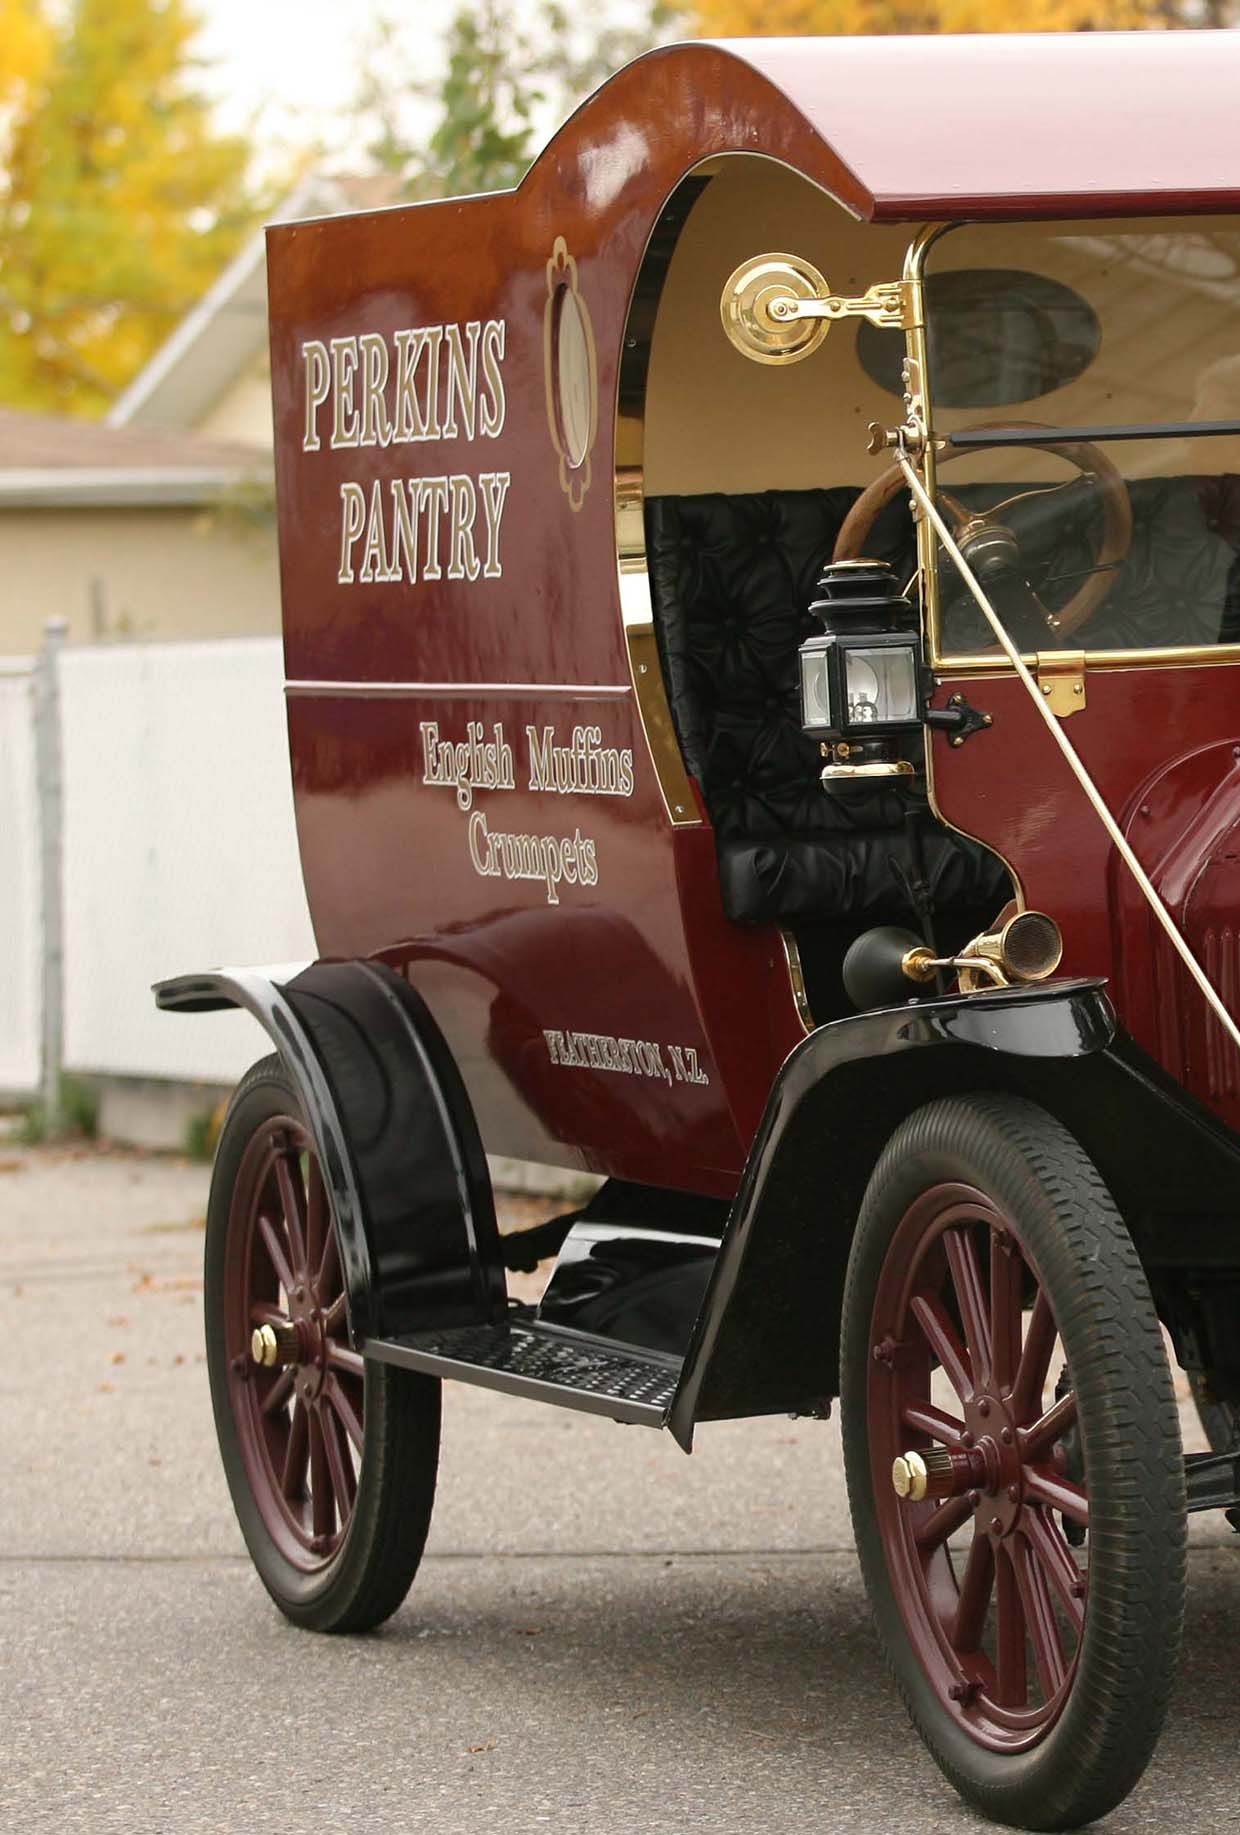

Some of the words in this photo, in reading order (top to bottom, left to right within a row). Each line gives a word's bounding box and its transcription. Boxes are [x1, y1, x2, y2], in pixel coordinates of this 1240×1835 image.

[302, 319, 506, 452] PERKINS
[338, 472, 511, 584] PANTRY
[419, 721, 516, 811] English
[526, 725, 635, 797] Muffins
[469, 811, 598, 904] Crumpets
